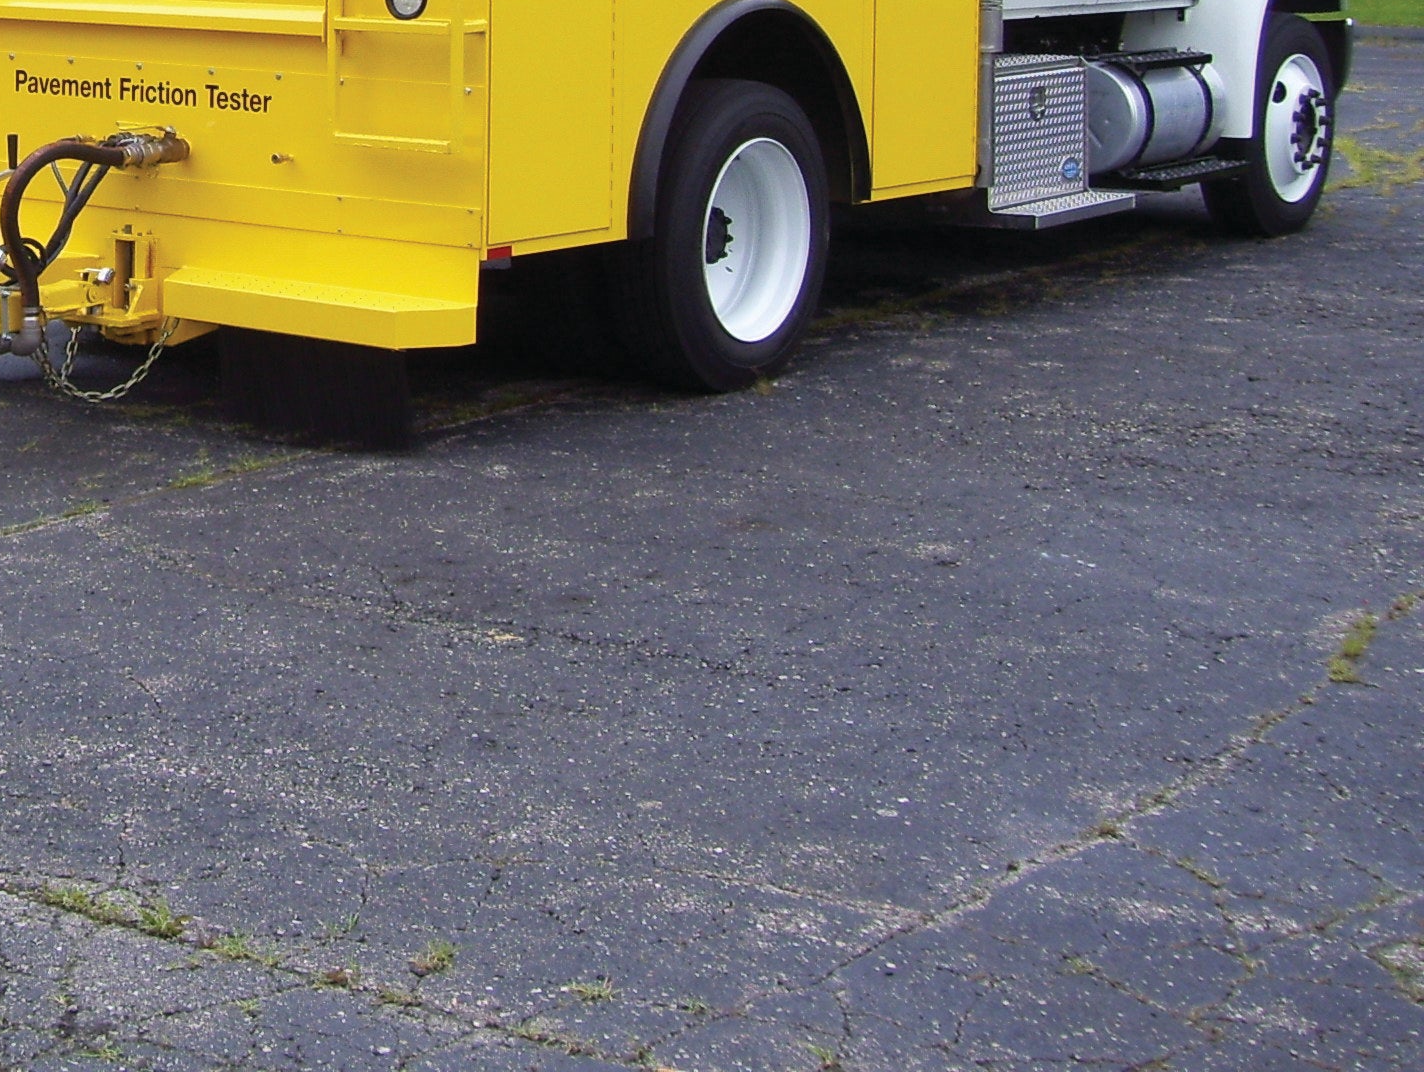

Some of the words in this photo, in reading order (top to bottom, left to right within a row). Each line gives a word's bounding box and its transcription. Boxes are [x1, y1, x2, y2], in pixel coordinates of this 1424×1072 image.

[15, 69, 112, 99] Pavement
[119, 77, 197, 107] Friction
[205, 84, 272, 113] Tester
